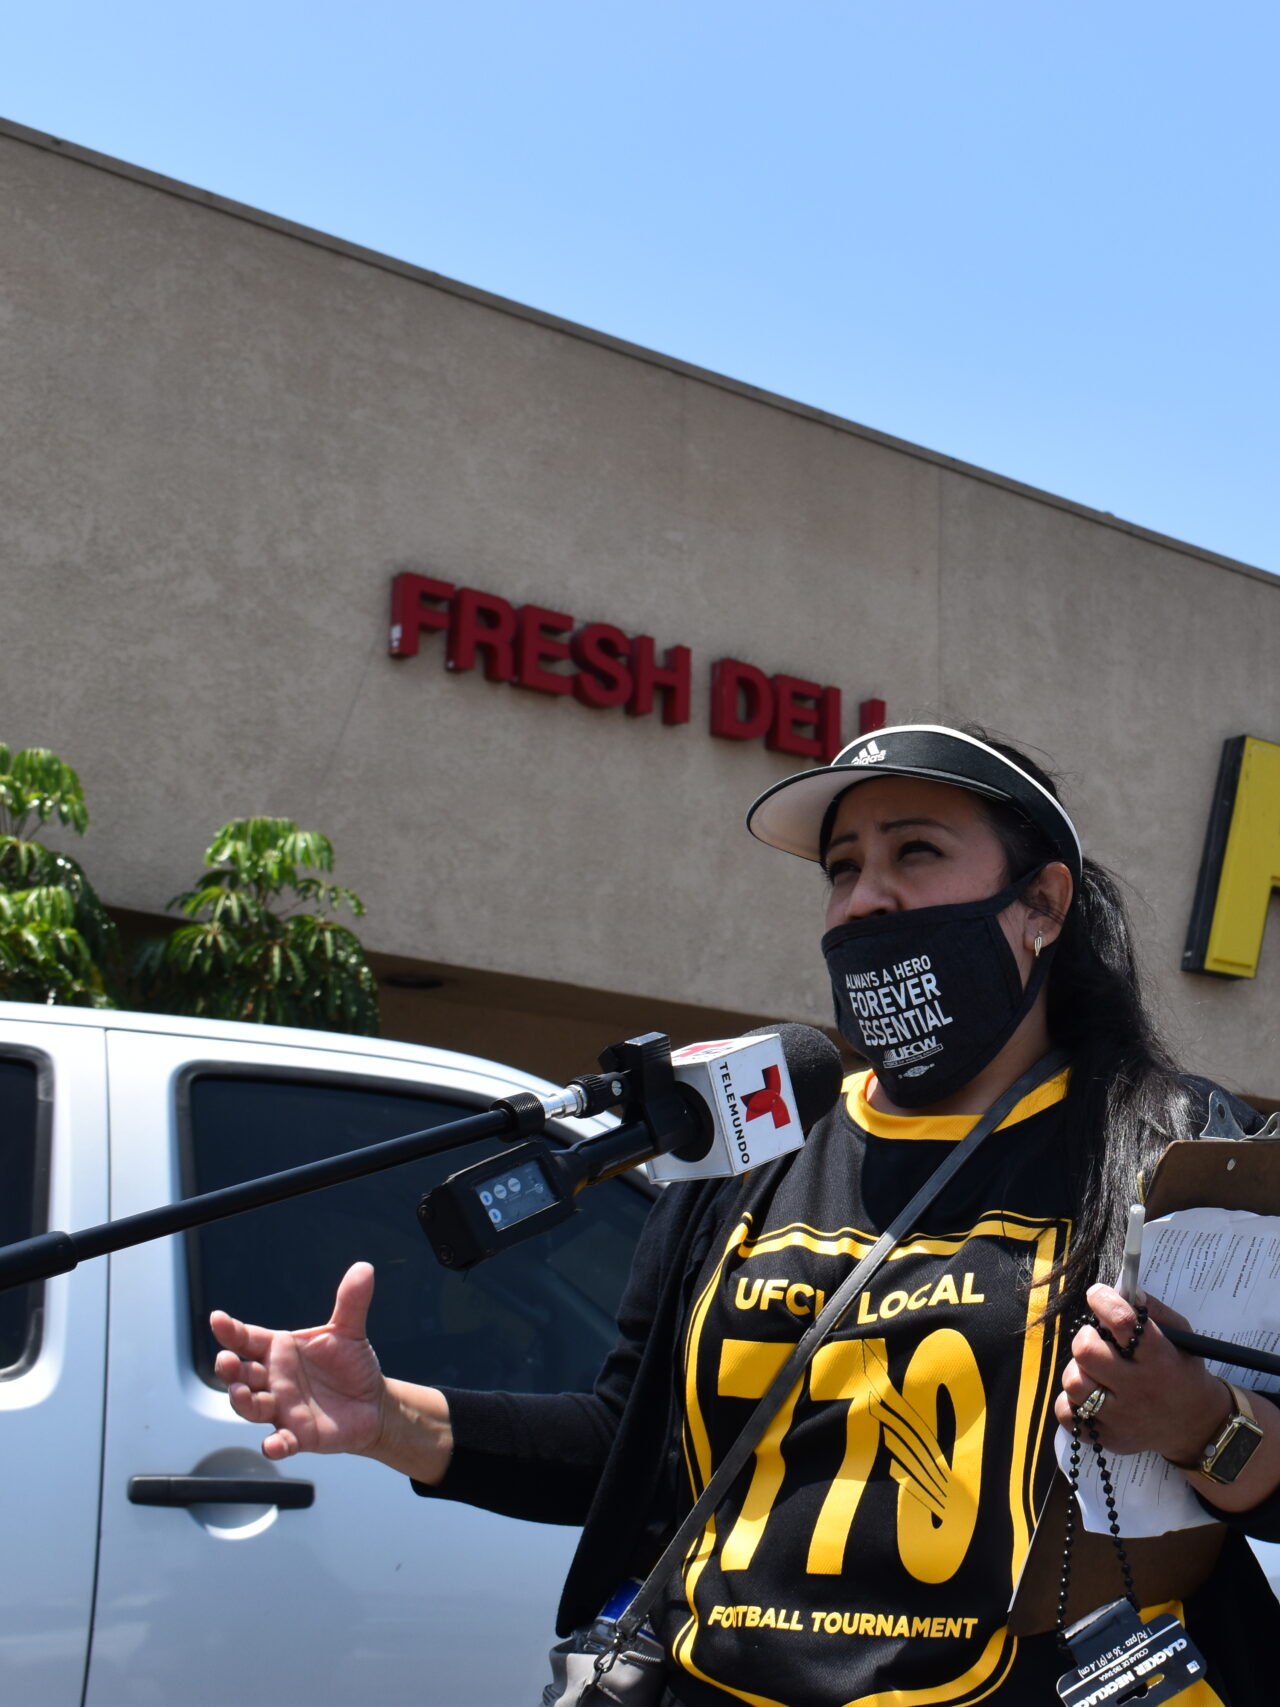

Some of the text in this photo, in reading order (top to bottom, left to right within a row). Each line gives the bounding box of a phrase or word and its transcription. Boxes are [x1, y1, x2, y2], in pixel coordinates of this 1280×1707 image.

[389, 571, 692, 726] FRESH
[845, 954, 932, 990] ALWAYS A HERO
[849, 972, 942, 1019] FOREVER
[858, 999, 954, 1047] ESSENTIAL
[889, 1035, 937, 1061] UFCW
[719, 1061, 751, 1165] TELEMUNDO
[857, 1272, 985, 1325] LOCAL
[717, 1327, 987, 1585] 770
[811, 1611, 979, 1640] TOURNAMENT
[1112, 1645, 1124, 1656] 36
[1129, 1647, 1149, 1664] COLLAR
[1132, 1638, 1188, 1677] CLACKER
[1071, 1670, 1136, 1707] NECKLAC
